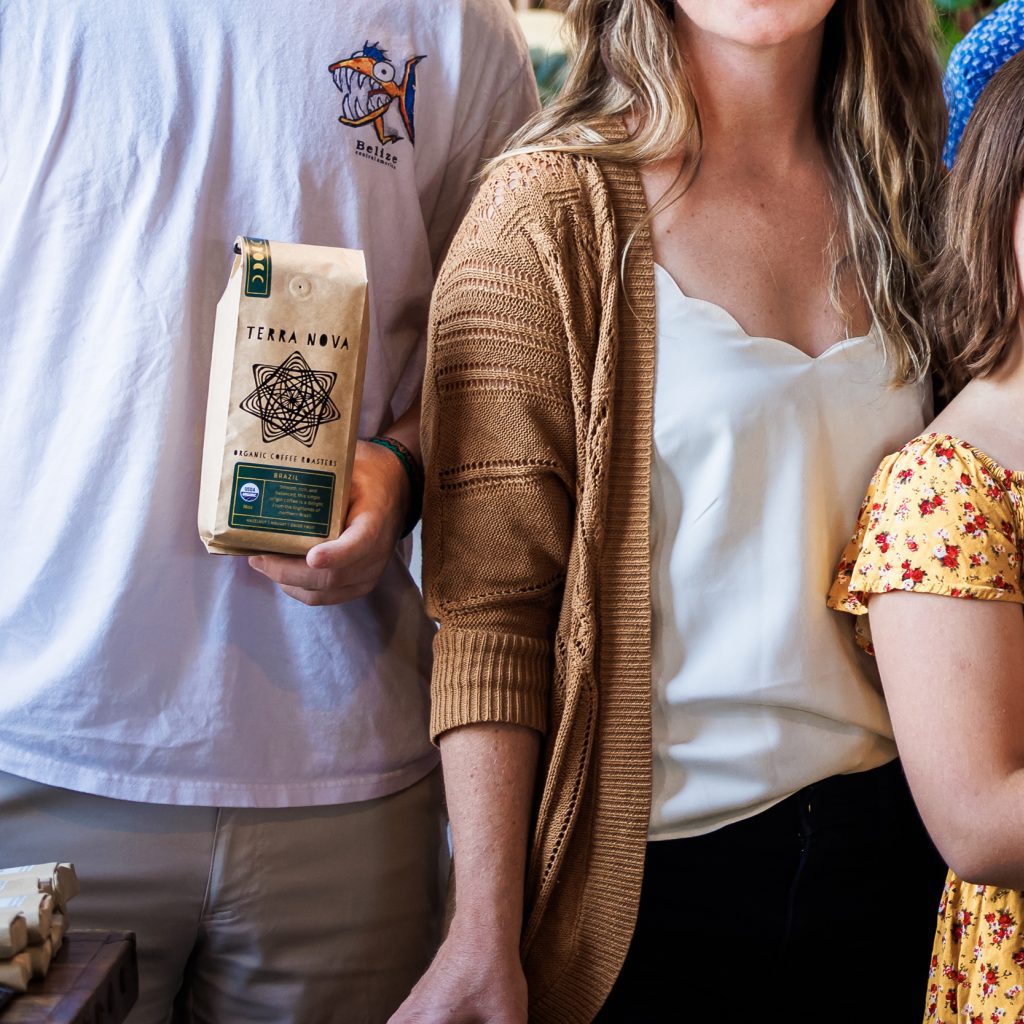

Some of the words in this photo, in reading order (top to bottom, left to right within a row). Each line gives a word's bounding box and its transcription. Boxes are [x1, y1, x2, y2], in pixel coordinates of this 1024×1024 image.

[356, 140, 398, 164] Belize
[246, 326, 298, 344] TERRA
[307, 332, 350, 350] NOVA
[234, 450, 266, 459] ORGANIC
[270, 453, 297, 462] COFFEE
[301, 456, 337, 466] ROASTERS
[273, 472, 299, 480] BRAZIL
